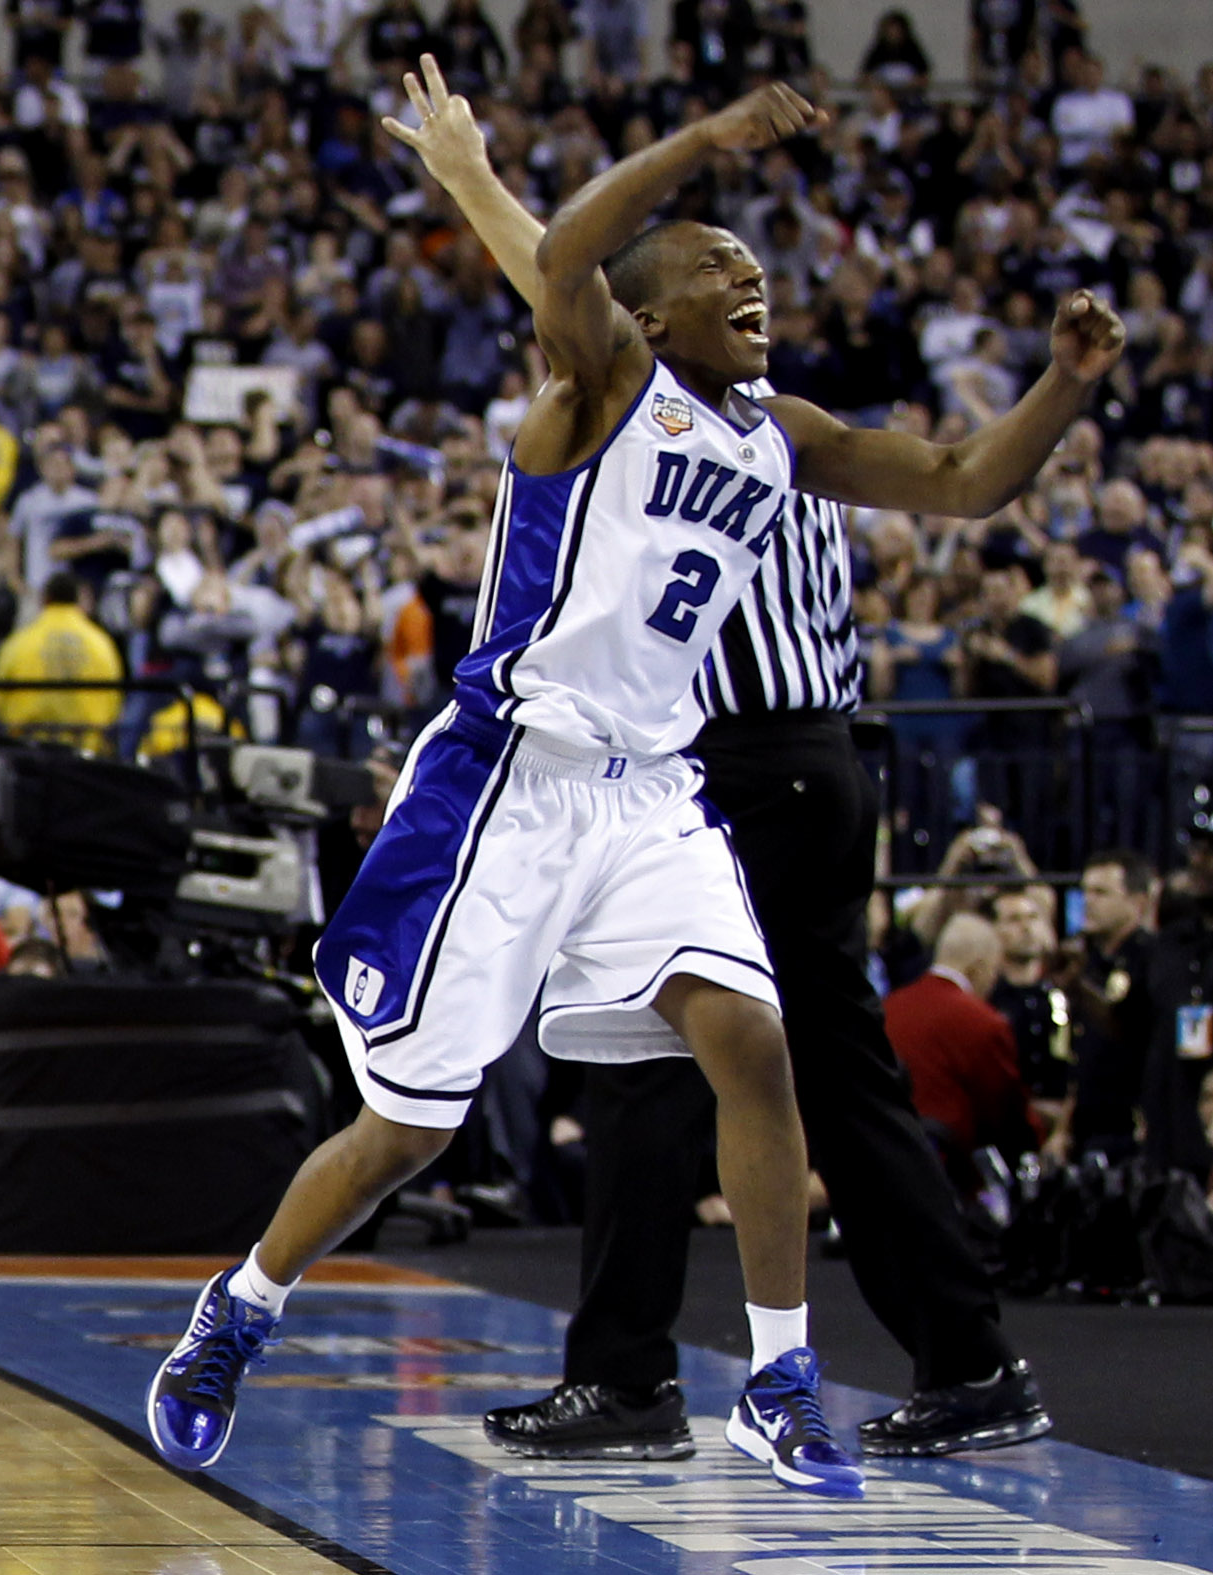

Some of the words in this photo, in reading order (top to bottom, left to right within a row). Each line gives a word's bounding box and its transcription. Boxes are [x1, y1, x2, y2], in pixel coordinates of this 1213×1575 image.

[652, 403, 692, 424] FOUR
[663, 398, 691, 414] FINAL
[645, 549, 721, 644] 2
[601, 756, 628, 779] D
